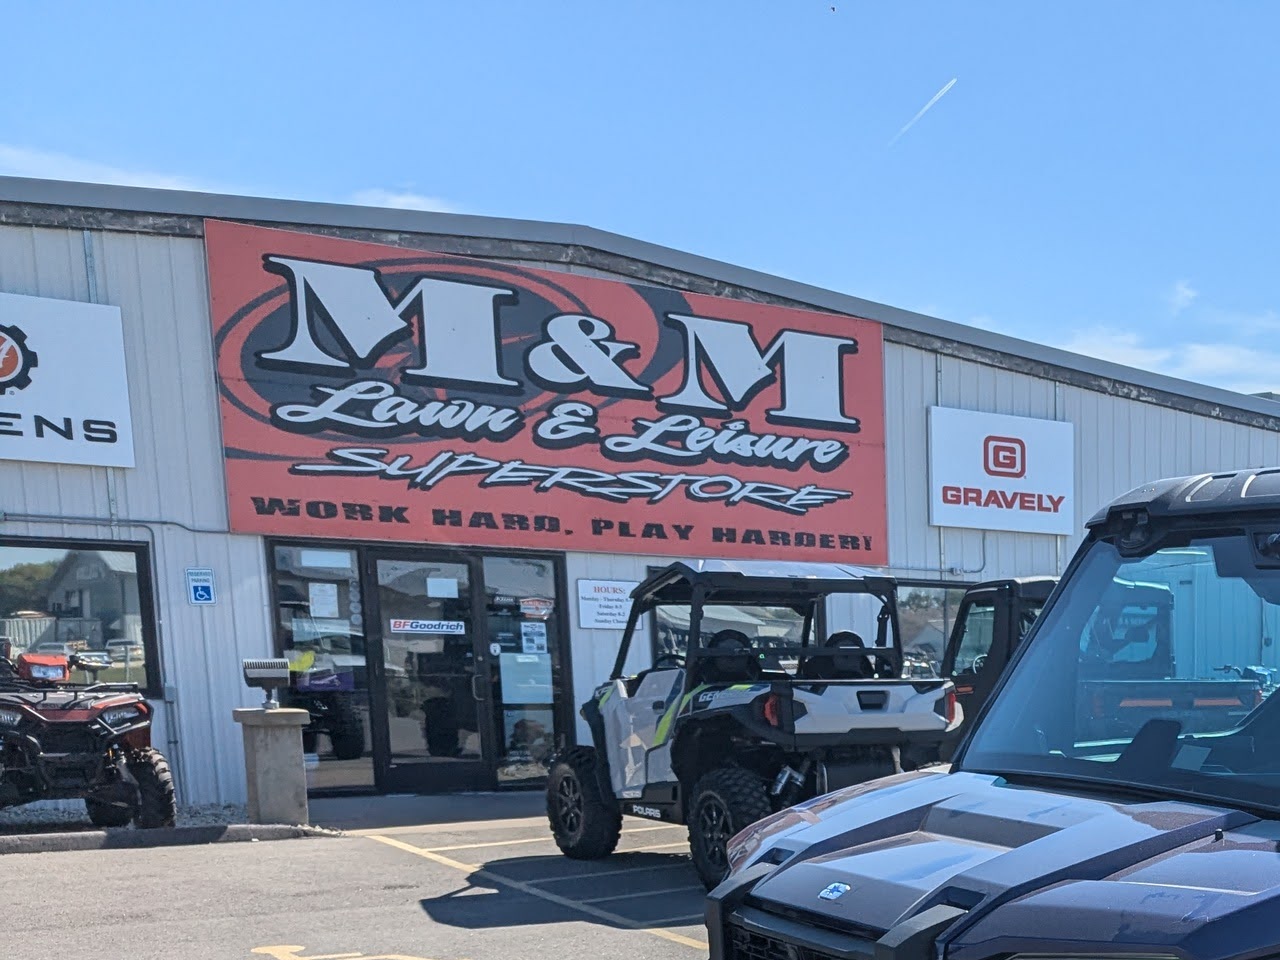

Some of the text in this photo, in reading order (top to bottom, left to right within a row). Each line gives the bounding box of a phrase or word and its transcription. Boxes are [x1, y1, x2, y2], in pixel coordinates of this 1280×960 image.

[275, 380, 848, 465] Lawn & Leisure
[292, 447, 856, 515] SUPERSTORE
[941, 485, 1067, 514] GRAVELY
[250, 496, 873, 551] WORK HARD, PLAY HARDER!
[593, 586, 626, 595] HOURS:
[392, 620, 463, 631] BFGoodrich
[632, 804, 661, 819] POLARIS
